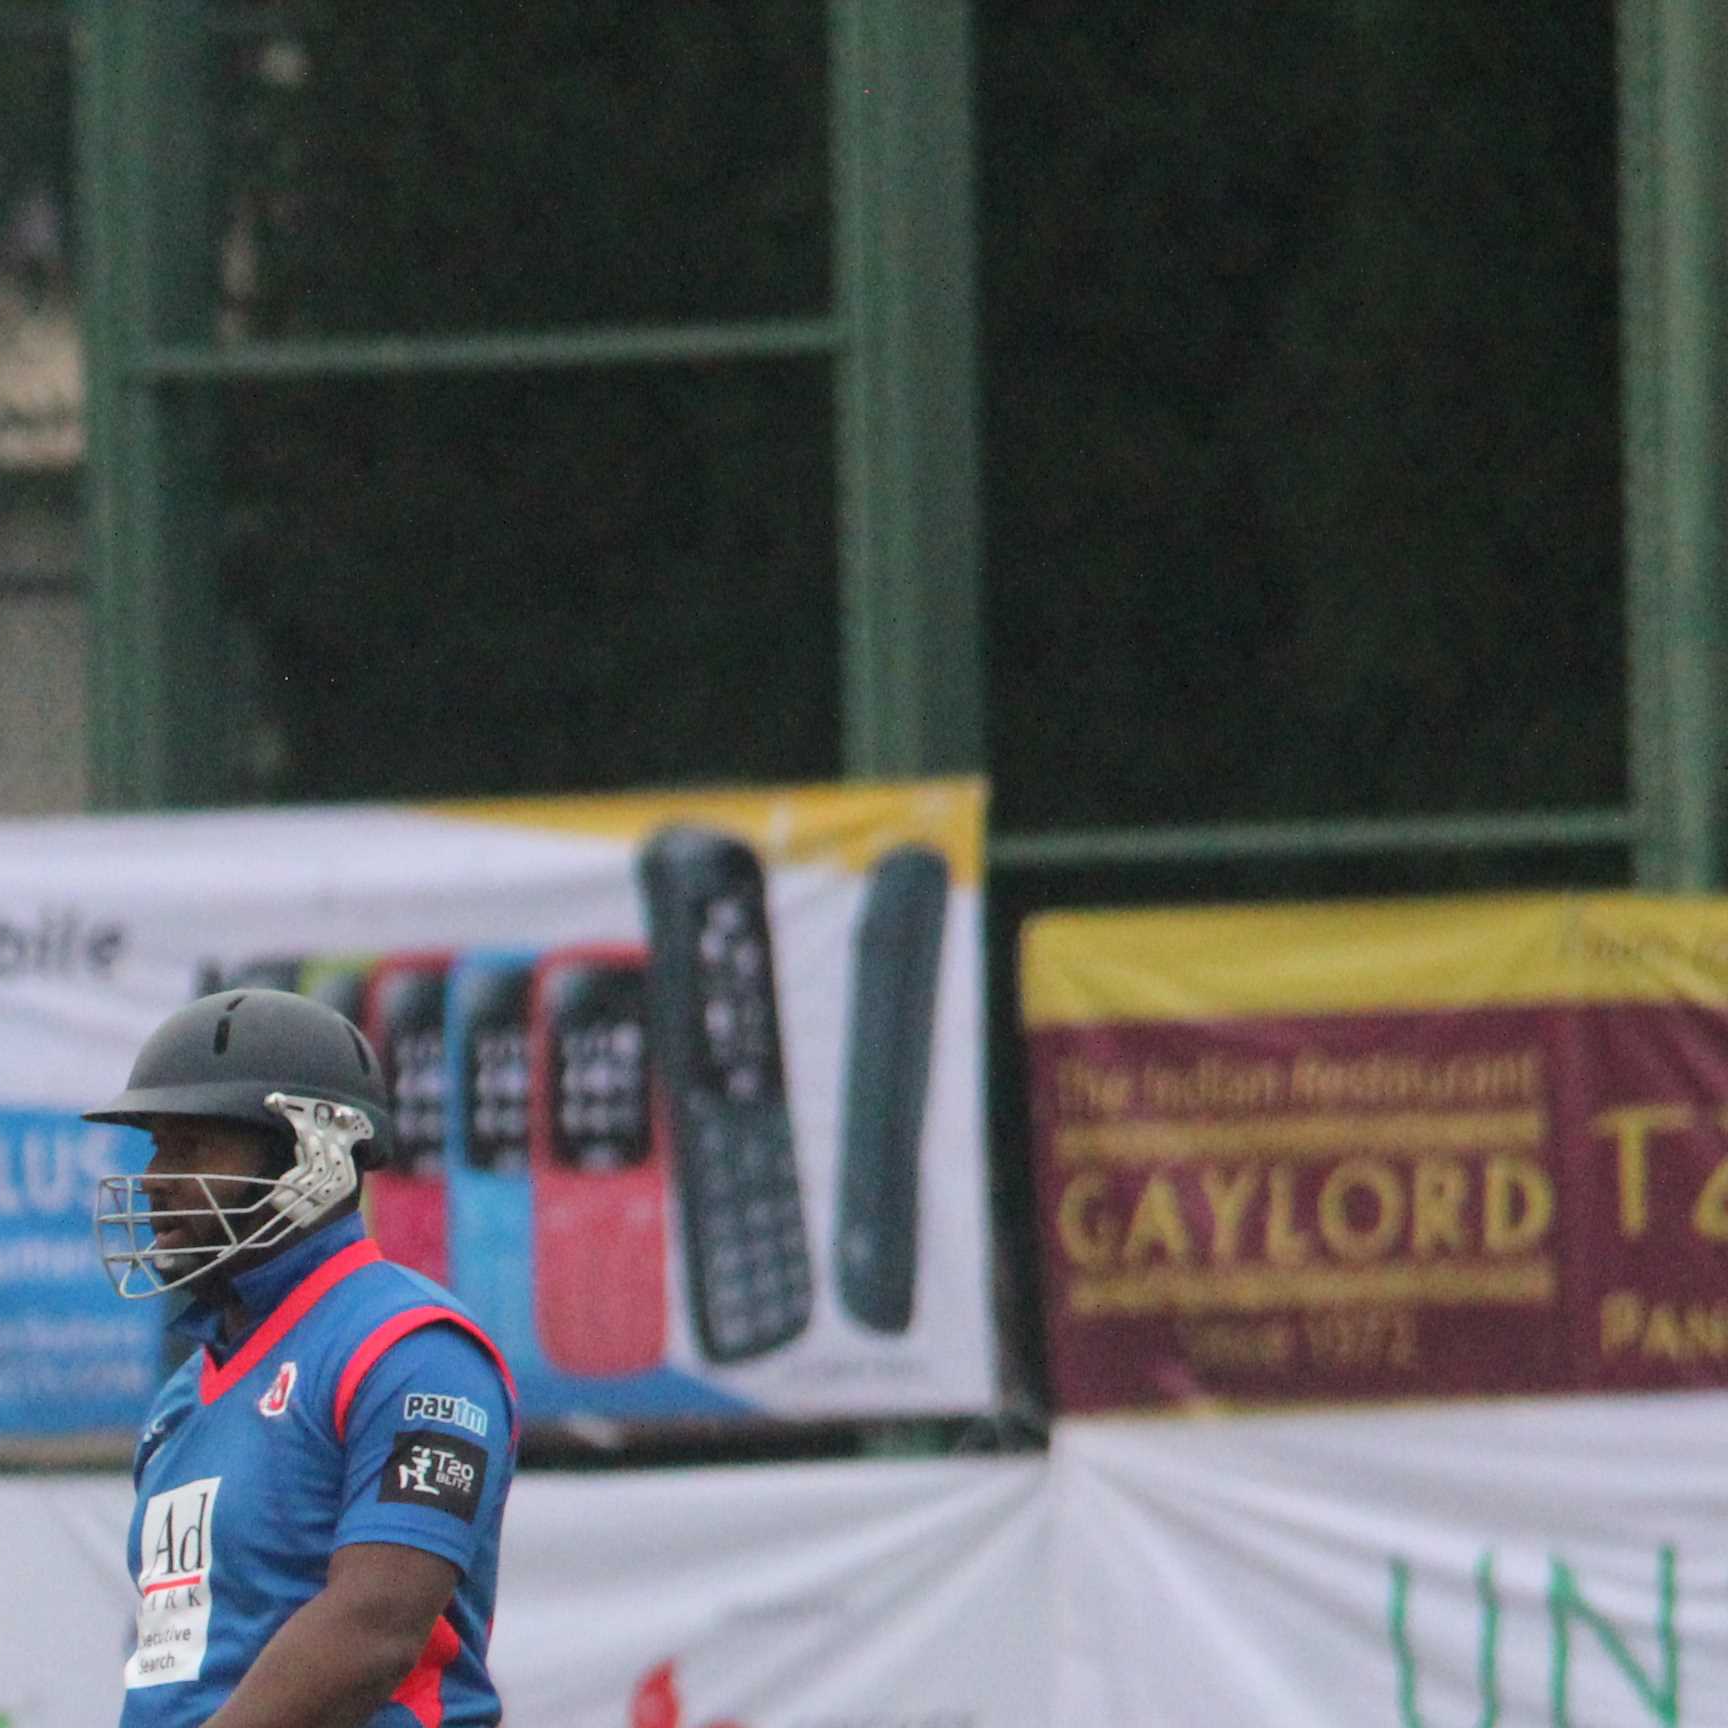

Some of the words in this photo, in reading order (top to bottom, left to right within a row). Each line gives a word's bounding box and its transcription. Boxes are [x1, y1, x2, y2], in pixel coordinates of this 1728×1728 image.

[1055, 1153, 1557, 1271] GAYLORD
[405, 1394, 488, 1437] paytm
[432, 1449, 475, 1481] T20
[435, 1471, 473, 1493] BLITZ
[142, 1492, 209, 1581] Ad
